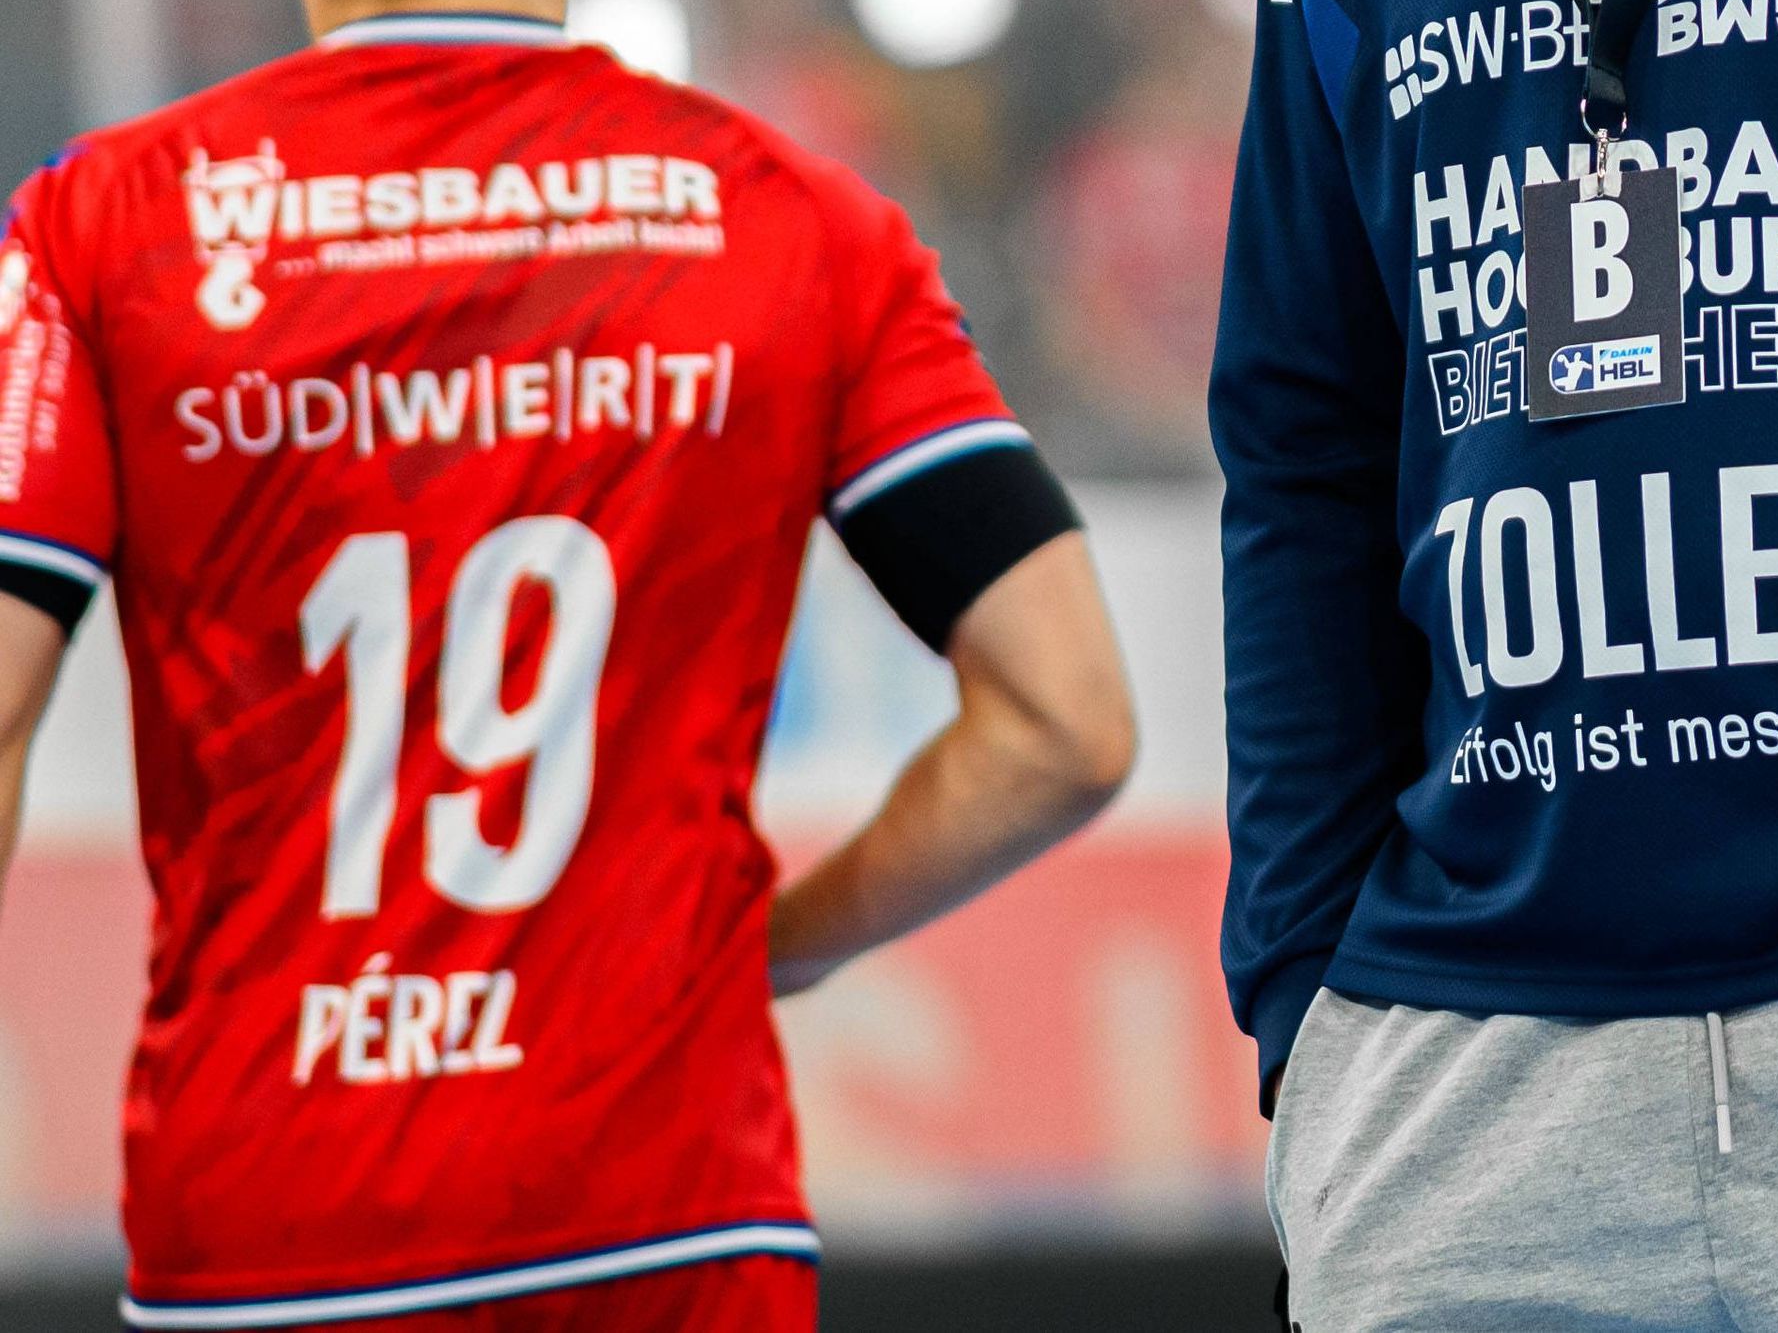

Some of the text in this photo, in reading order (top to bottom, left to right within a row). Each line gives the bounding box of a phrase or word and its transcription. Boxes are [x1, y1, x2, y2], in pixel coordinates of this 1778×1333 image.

[189, 155, 721, 244] WIESBAUER
[1570, 198, 1634, 323] B
[1600, 359, 1655, 382] HBL
[1610, 346, 1654, 359] DAIKIN
[298, 514, 618, 923] 19
[1451, 720, 1557, 792] Erfolg
[1573, 708, 1648, 773] ist
[291, 951, 525, 1085] PÉREZ
